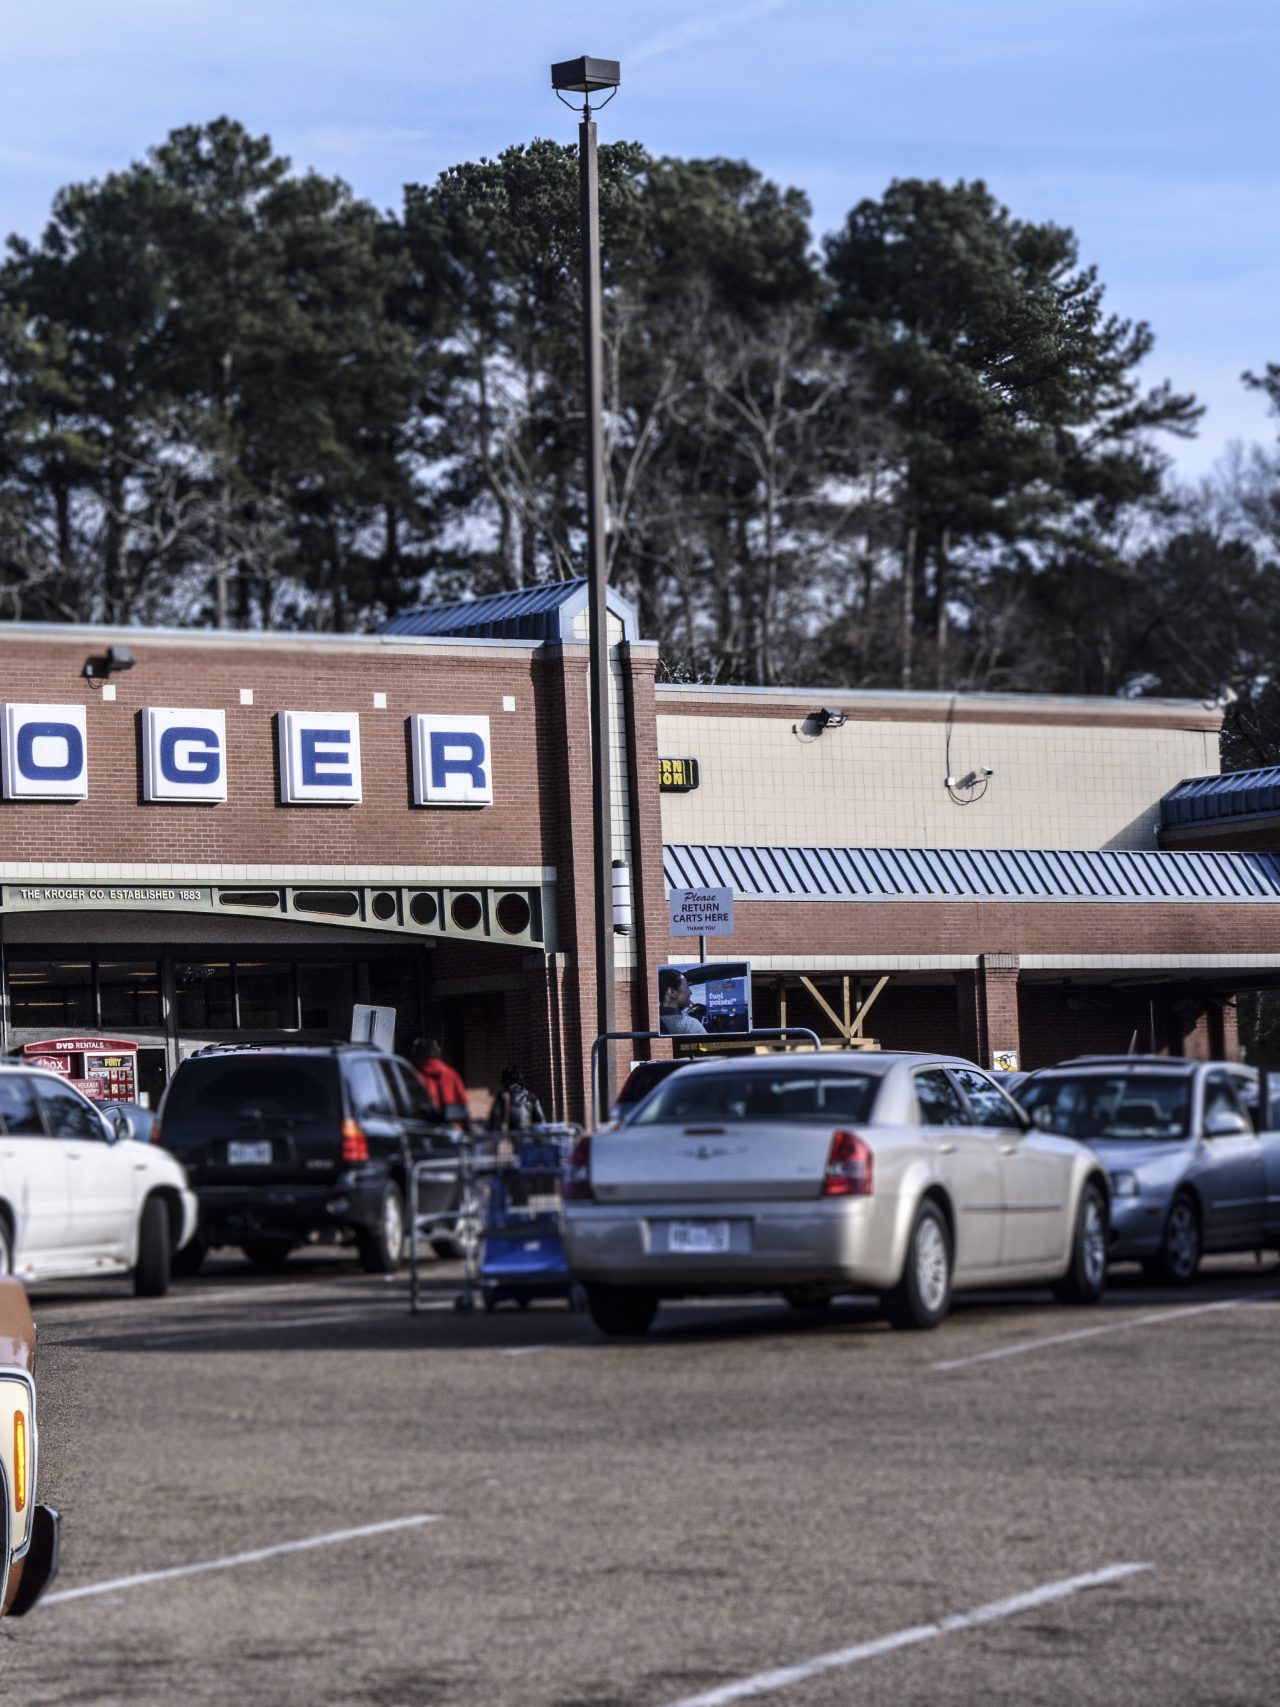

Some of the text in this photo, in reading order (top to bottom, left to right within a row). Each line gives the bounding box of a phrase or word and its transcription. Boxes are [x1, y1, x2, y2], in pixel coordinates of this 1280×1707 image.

[21, 889, 201, 900] THE KROGER CO. ESTABLISHED 1883
[684, 891, 717, 902] Please
[681, 903, 719, 912] RETURN
[673, 913, 729, 923] CARTS HERE
[56, 1042, 104, 1050] DVD RENTALS
